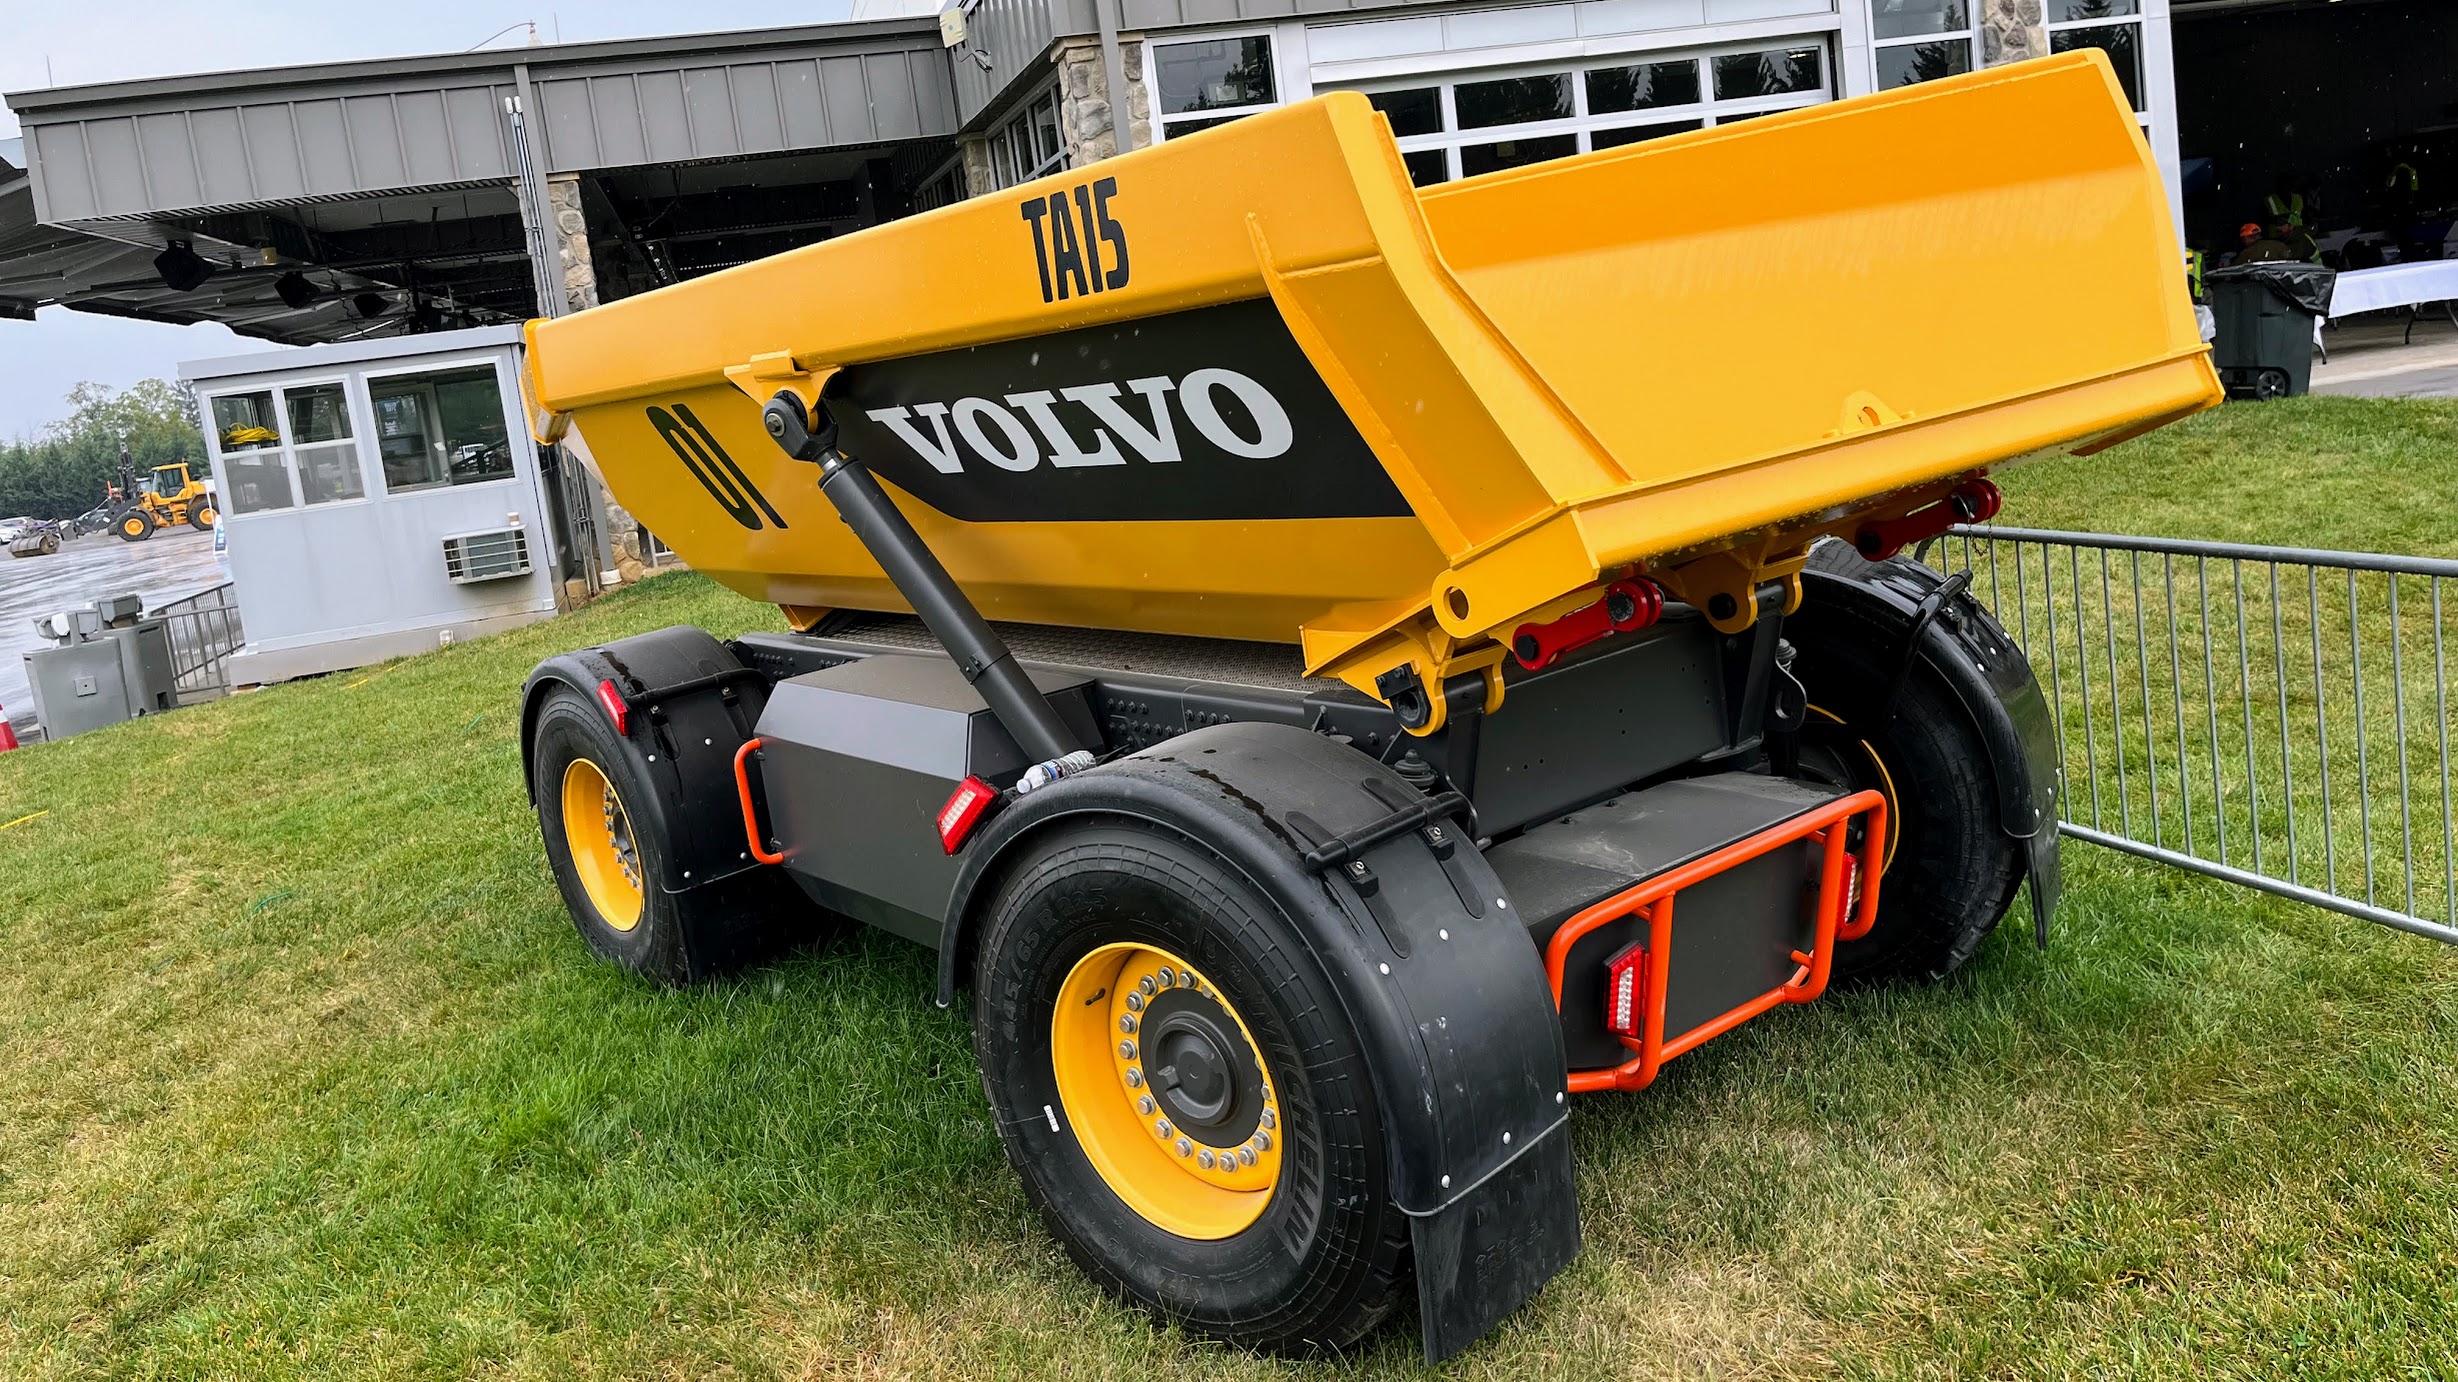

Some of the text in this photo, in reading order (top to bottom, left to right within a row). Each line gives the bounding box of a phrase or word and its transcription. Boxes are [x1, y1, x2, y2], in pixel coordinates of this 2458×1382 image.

[1021, 177, 1130, 303] TA15
[646, 404, 788, 530] 01
[867, 368, 1294, 474] VOLVO
[1247, 995, 1318, 1252] MICHELIN
